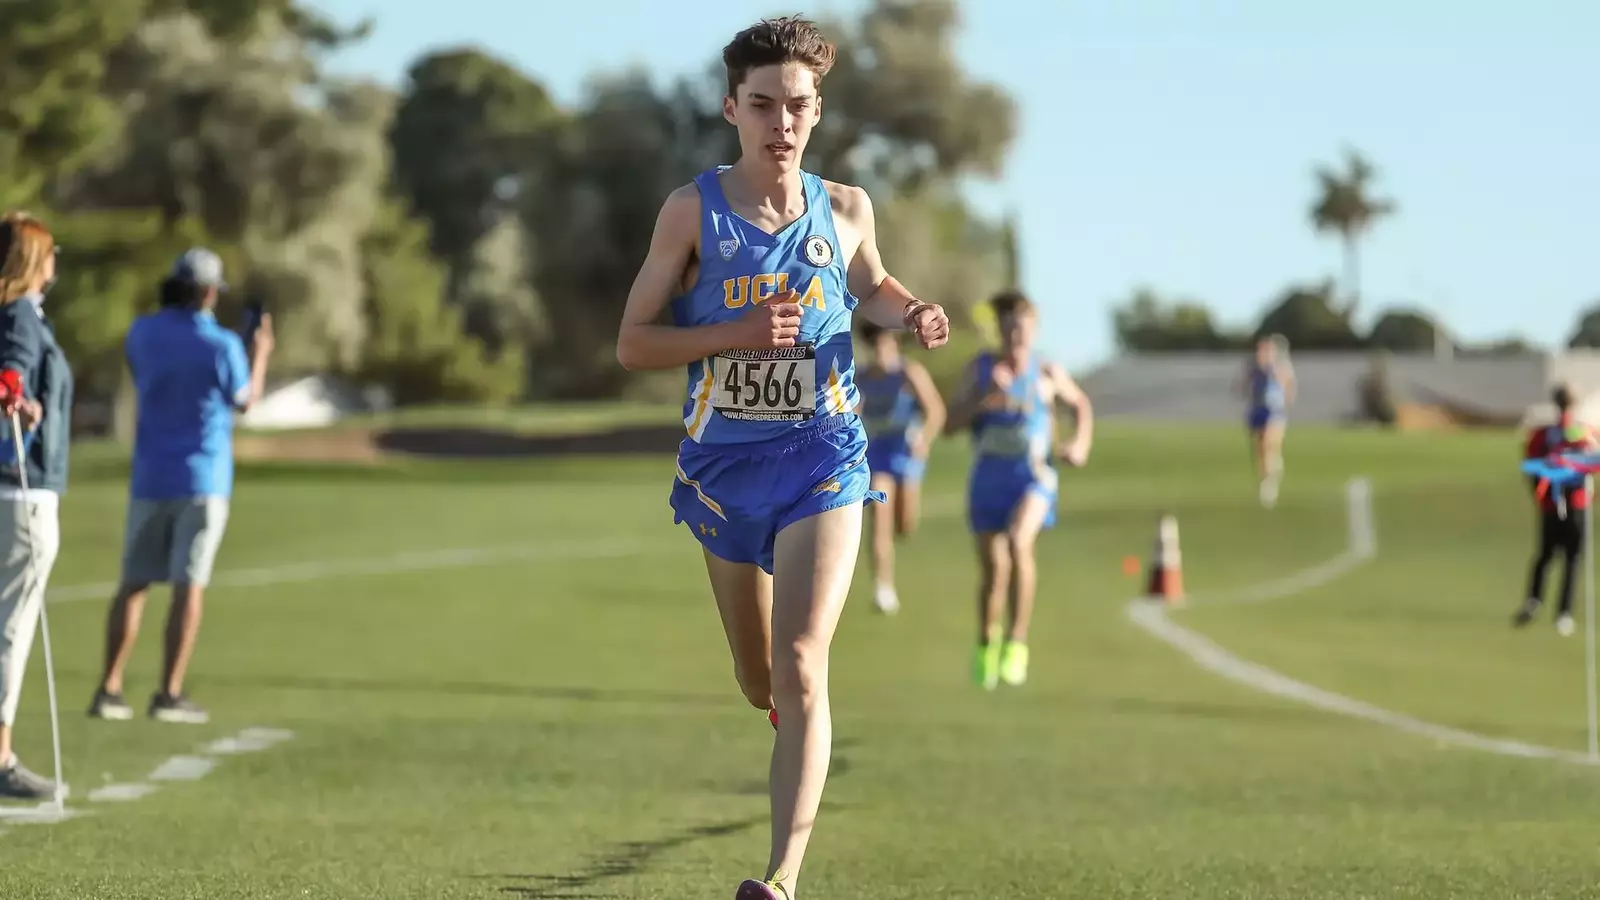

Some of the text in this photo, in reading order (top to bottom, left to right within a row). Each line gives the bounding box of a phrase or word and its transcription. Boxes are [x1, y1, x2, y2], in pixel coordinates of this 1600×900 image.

[724, 273, 826, 311] UCLA
[761, 347, 806, 359] RESULTS
[725, 362, 802, 407] 4566
[721, 411, 804, 422] WWW.FINISHEDRESULTS.COM
